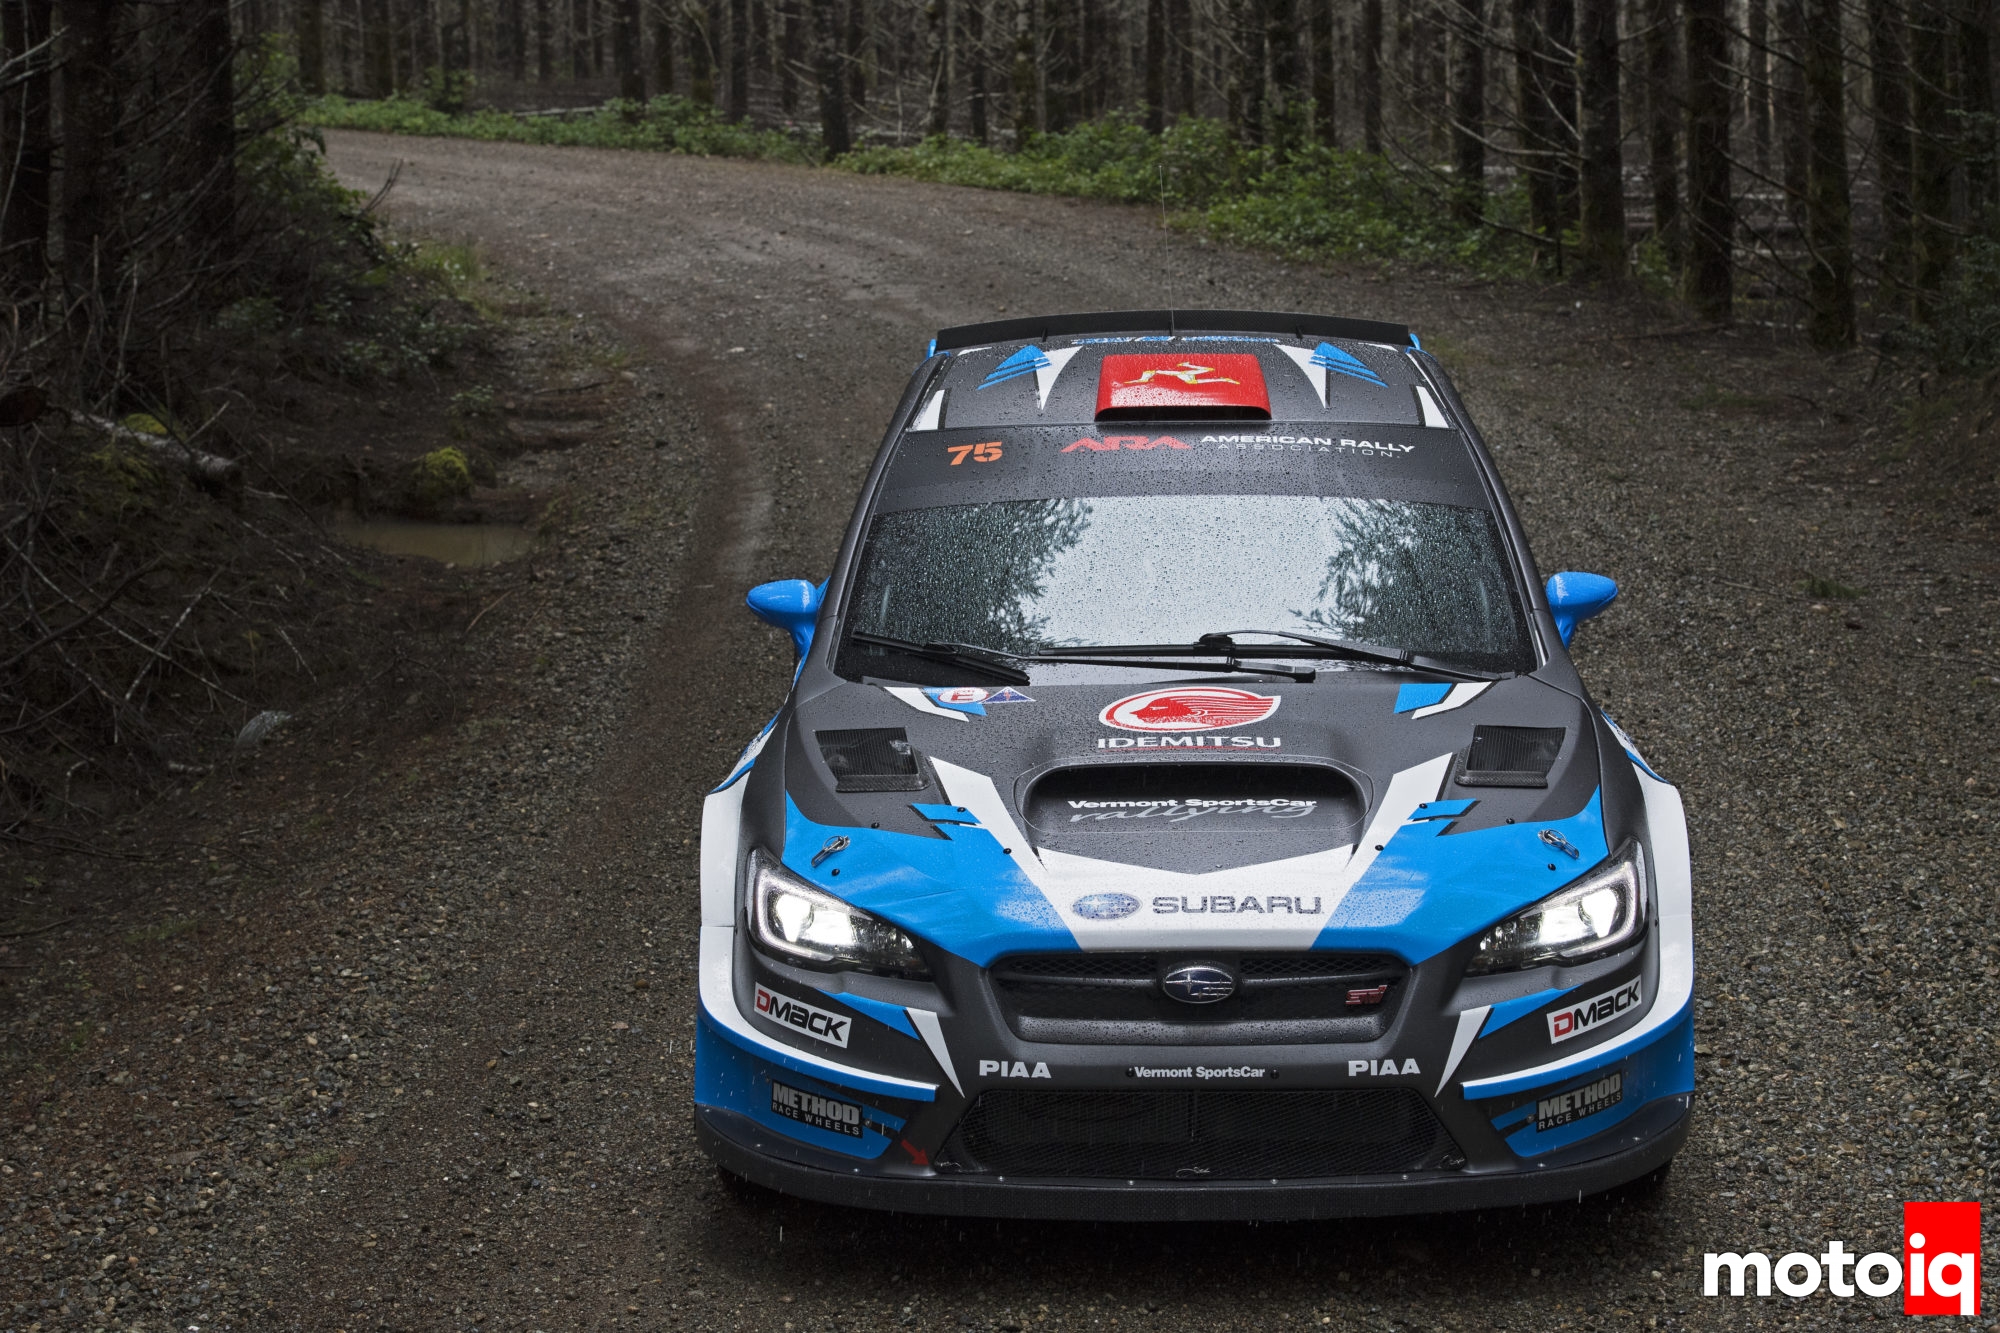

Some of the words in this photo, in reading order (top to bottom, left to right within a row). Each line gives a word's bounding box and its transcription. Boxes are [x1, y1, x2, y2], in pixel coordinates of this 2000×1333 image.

[1060, 435, 1193, 452] ARA
[1200, 435, 1331, 446] AMERICAN
[1340, 438, 1416, 453] RALLY
[1218, 443, 1393, 458] ASSOCIATION
[947, 441, 1003, 466] 75
[1097, 735, 1282, 749] IDEMITSU
[1067, 799, 1179, 809] Vermont
[1184, 798, 1318, 809] SportsCar
[1152, 896, 1322, 915] SUBARU
[979, 1059, 1052, 1079] PIAA
[1134, 1066, 1193, 1078] Vermont
[1195, 1066, 1266, 1080] SportsCar
[1348, 1058, 1421, 1077] PIAA
[772, 1082, 860, 1126] METHOD
[1538, 1073, 1622, 1121] METHOD
[772, 1101, 799, 1119] RACE
[804, 1113, 860, 1136] WHEELS
[1538, 1112, 1572, 1131] RACE
[1578, 1093, 1622, 1118] WHEELS
